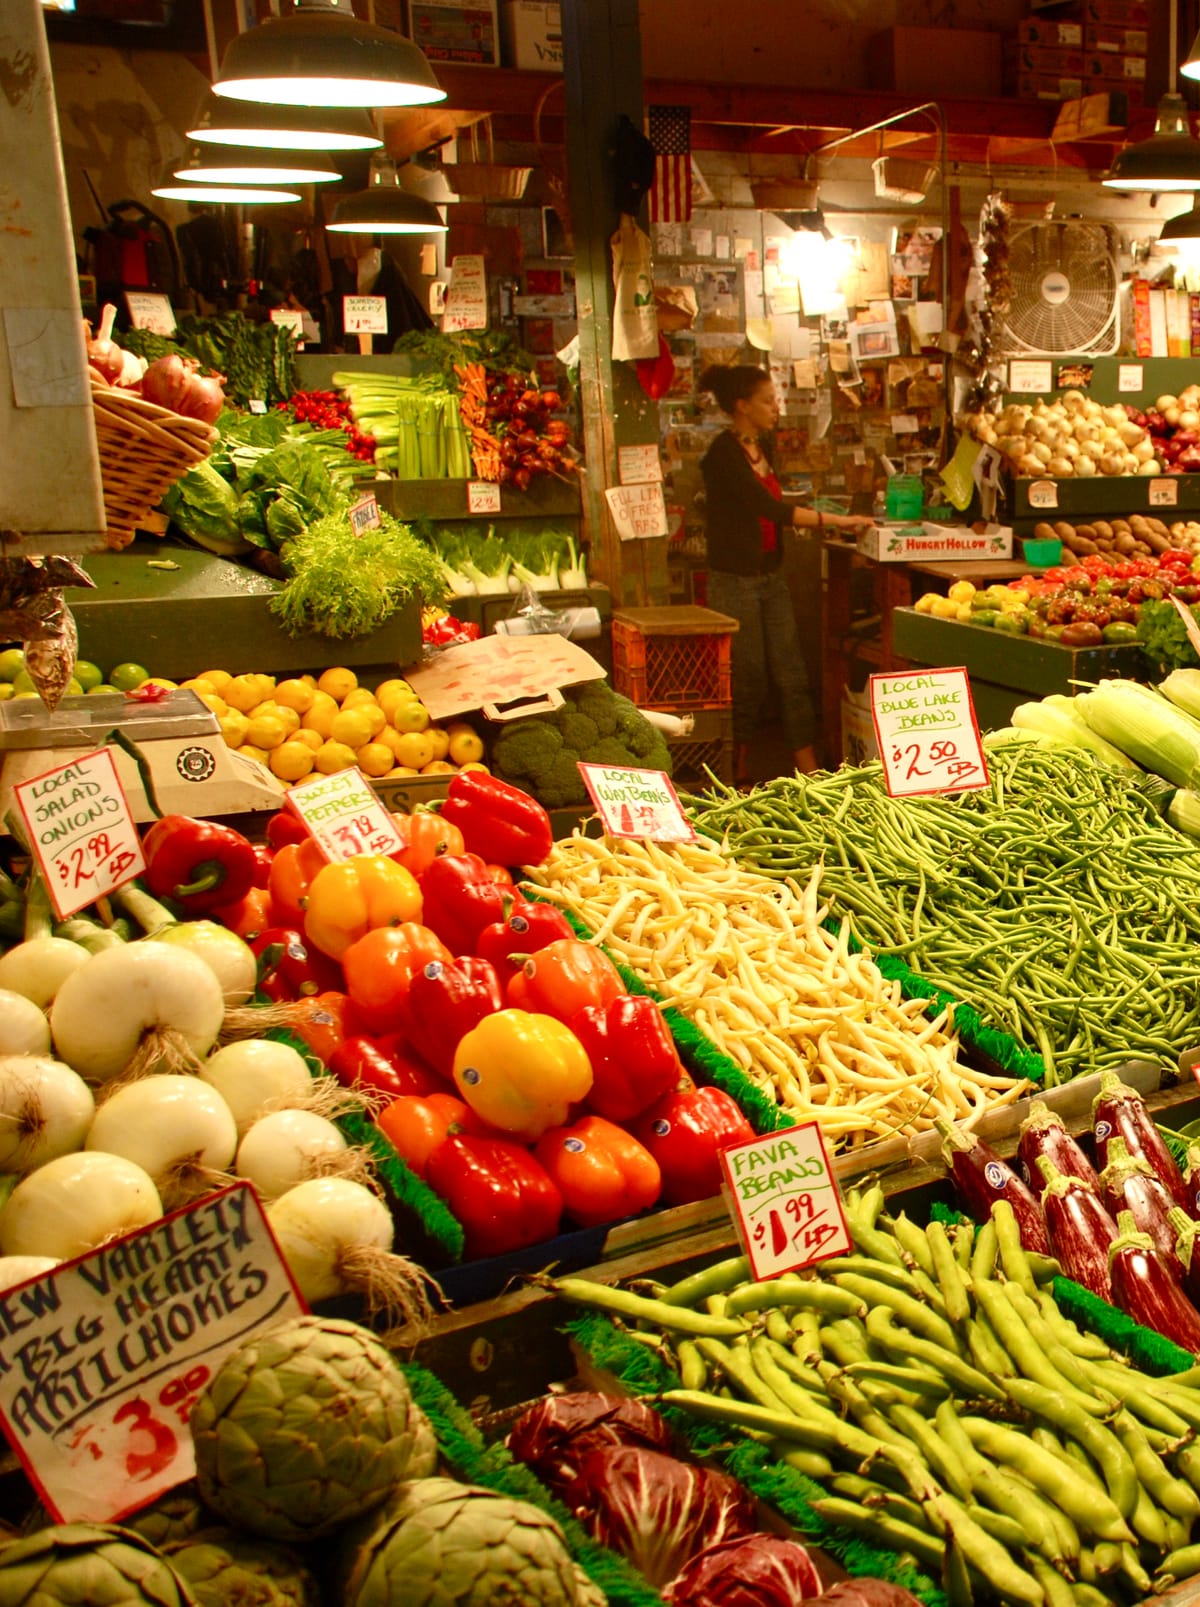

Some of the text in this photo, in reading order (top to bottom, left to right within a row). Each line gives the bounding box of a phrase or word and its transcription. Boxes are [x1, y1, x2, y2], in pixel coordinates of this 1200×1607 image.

[878, 691, 961, 714] BLUE LAKE
[882, 675, 944, 695] LOCAL
[896, 709, 956, 729] BEANS
[32, 761, 92, 799] LOCAL
[296, 773, 353, 806] SWEET
[597, 784, 626, 801] WAX
[602, 769, 652, 785] LOCAL
[35, 781, 101, 822] SALAD
[303, 790, 374, 823] PEPPERS
[40, 796, 119, 846] ONIONS
[732, 1140, 798, 1176] FAVA
[736, 1156, 824, 1200] BEANS
[78, 1187, 252, 1296] VARIETY
[14, 1239, 234, 1384] BIG HEART
[11, 1262, 268, 1438] ARTICHOKES
